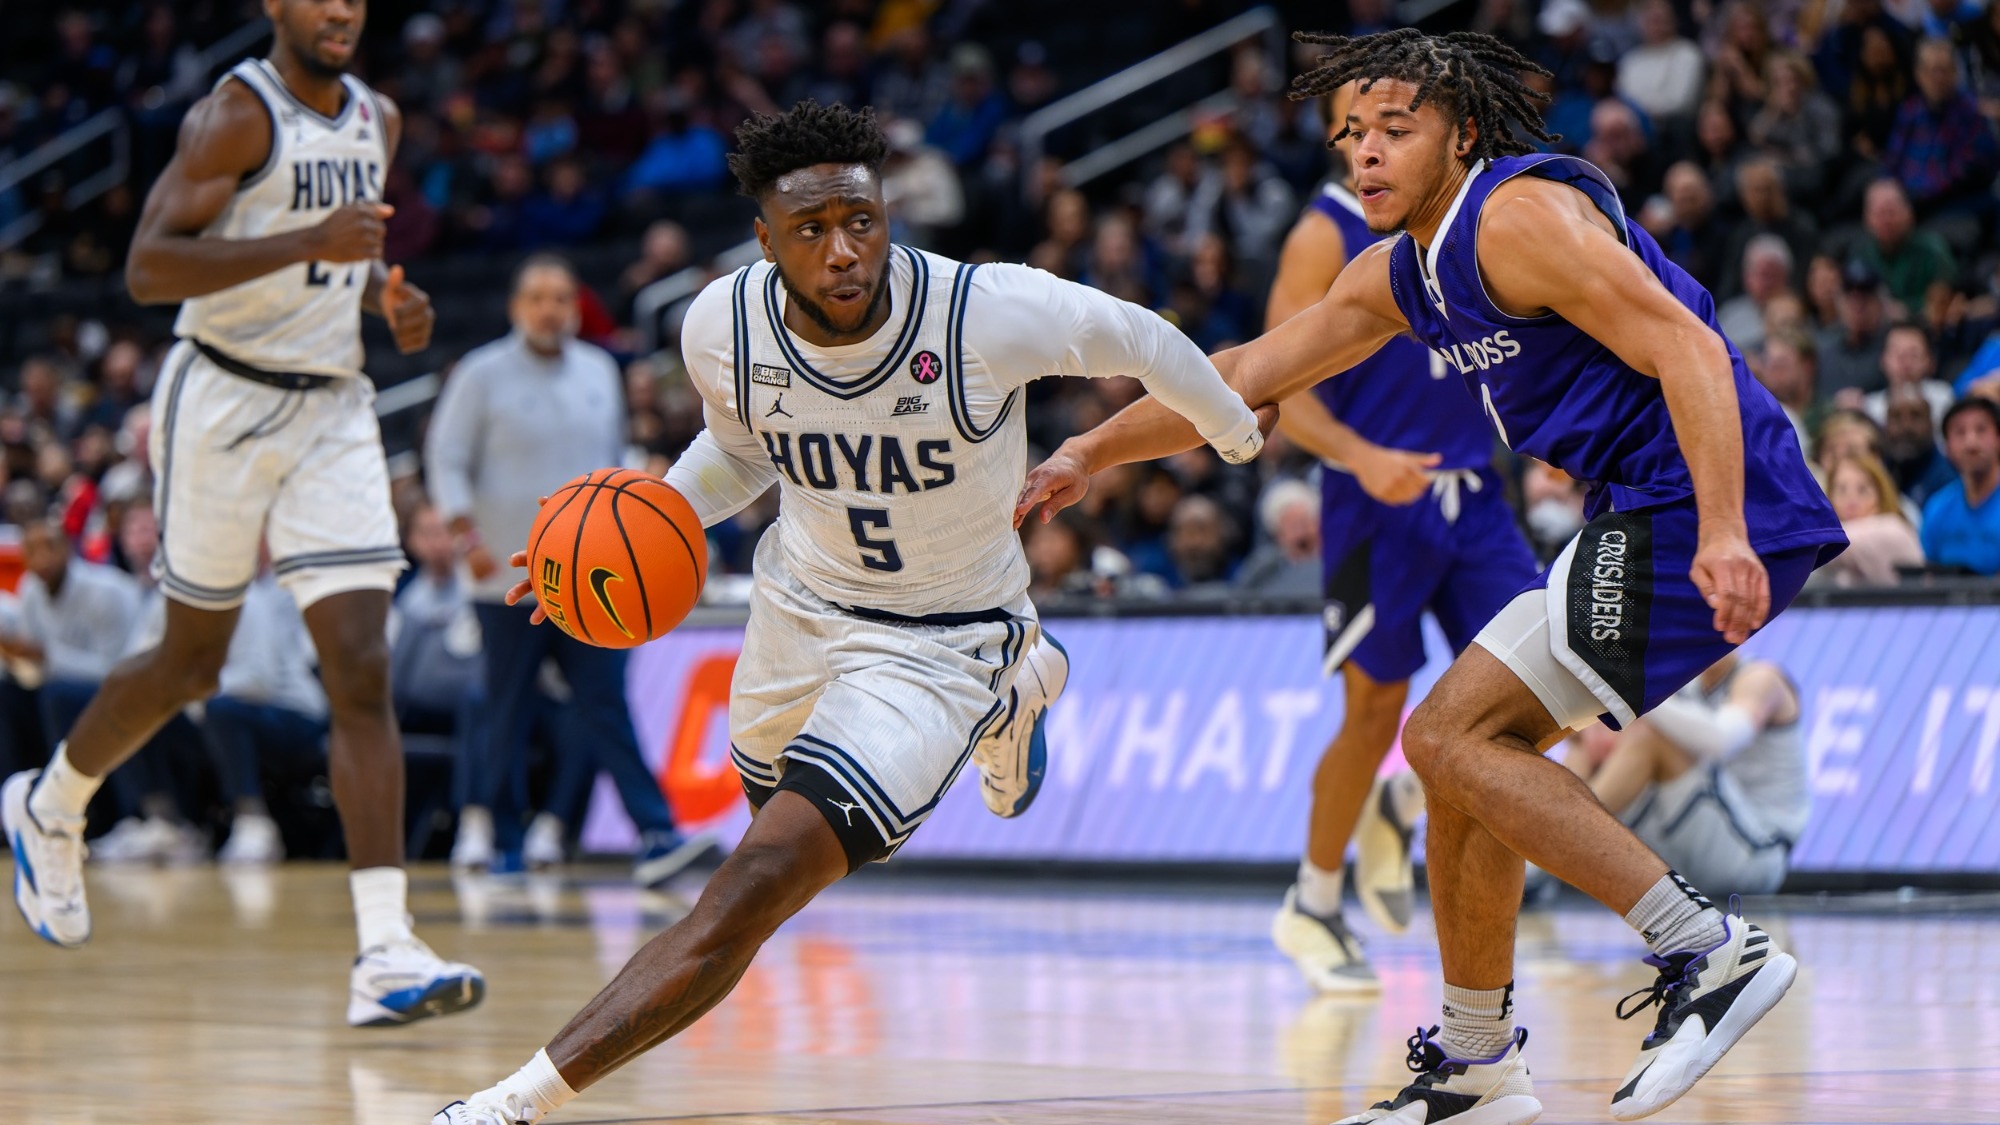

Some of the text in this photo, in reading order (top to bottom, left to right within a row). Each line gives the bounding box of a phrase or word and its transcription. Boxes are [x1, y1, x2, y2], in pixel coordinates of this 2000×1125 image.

[753, 374, 788, 387] CHANGE
[893, 402, 930, 413] EAST
[896, 395, 923, 406] BIG
[759, 430, 956, 494] HOYAS
[846, 505, 905, 573] 5
[1590, 530, 1627, 641] CRUSADERS
